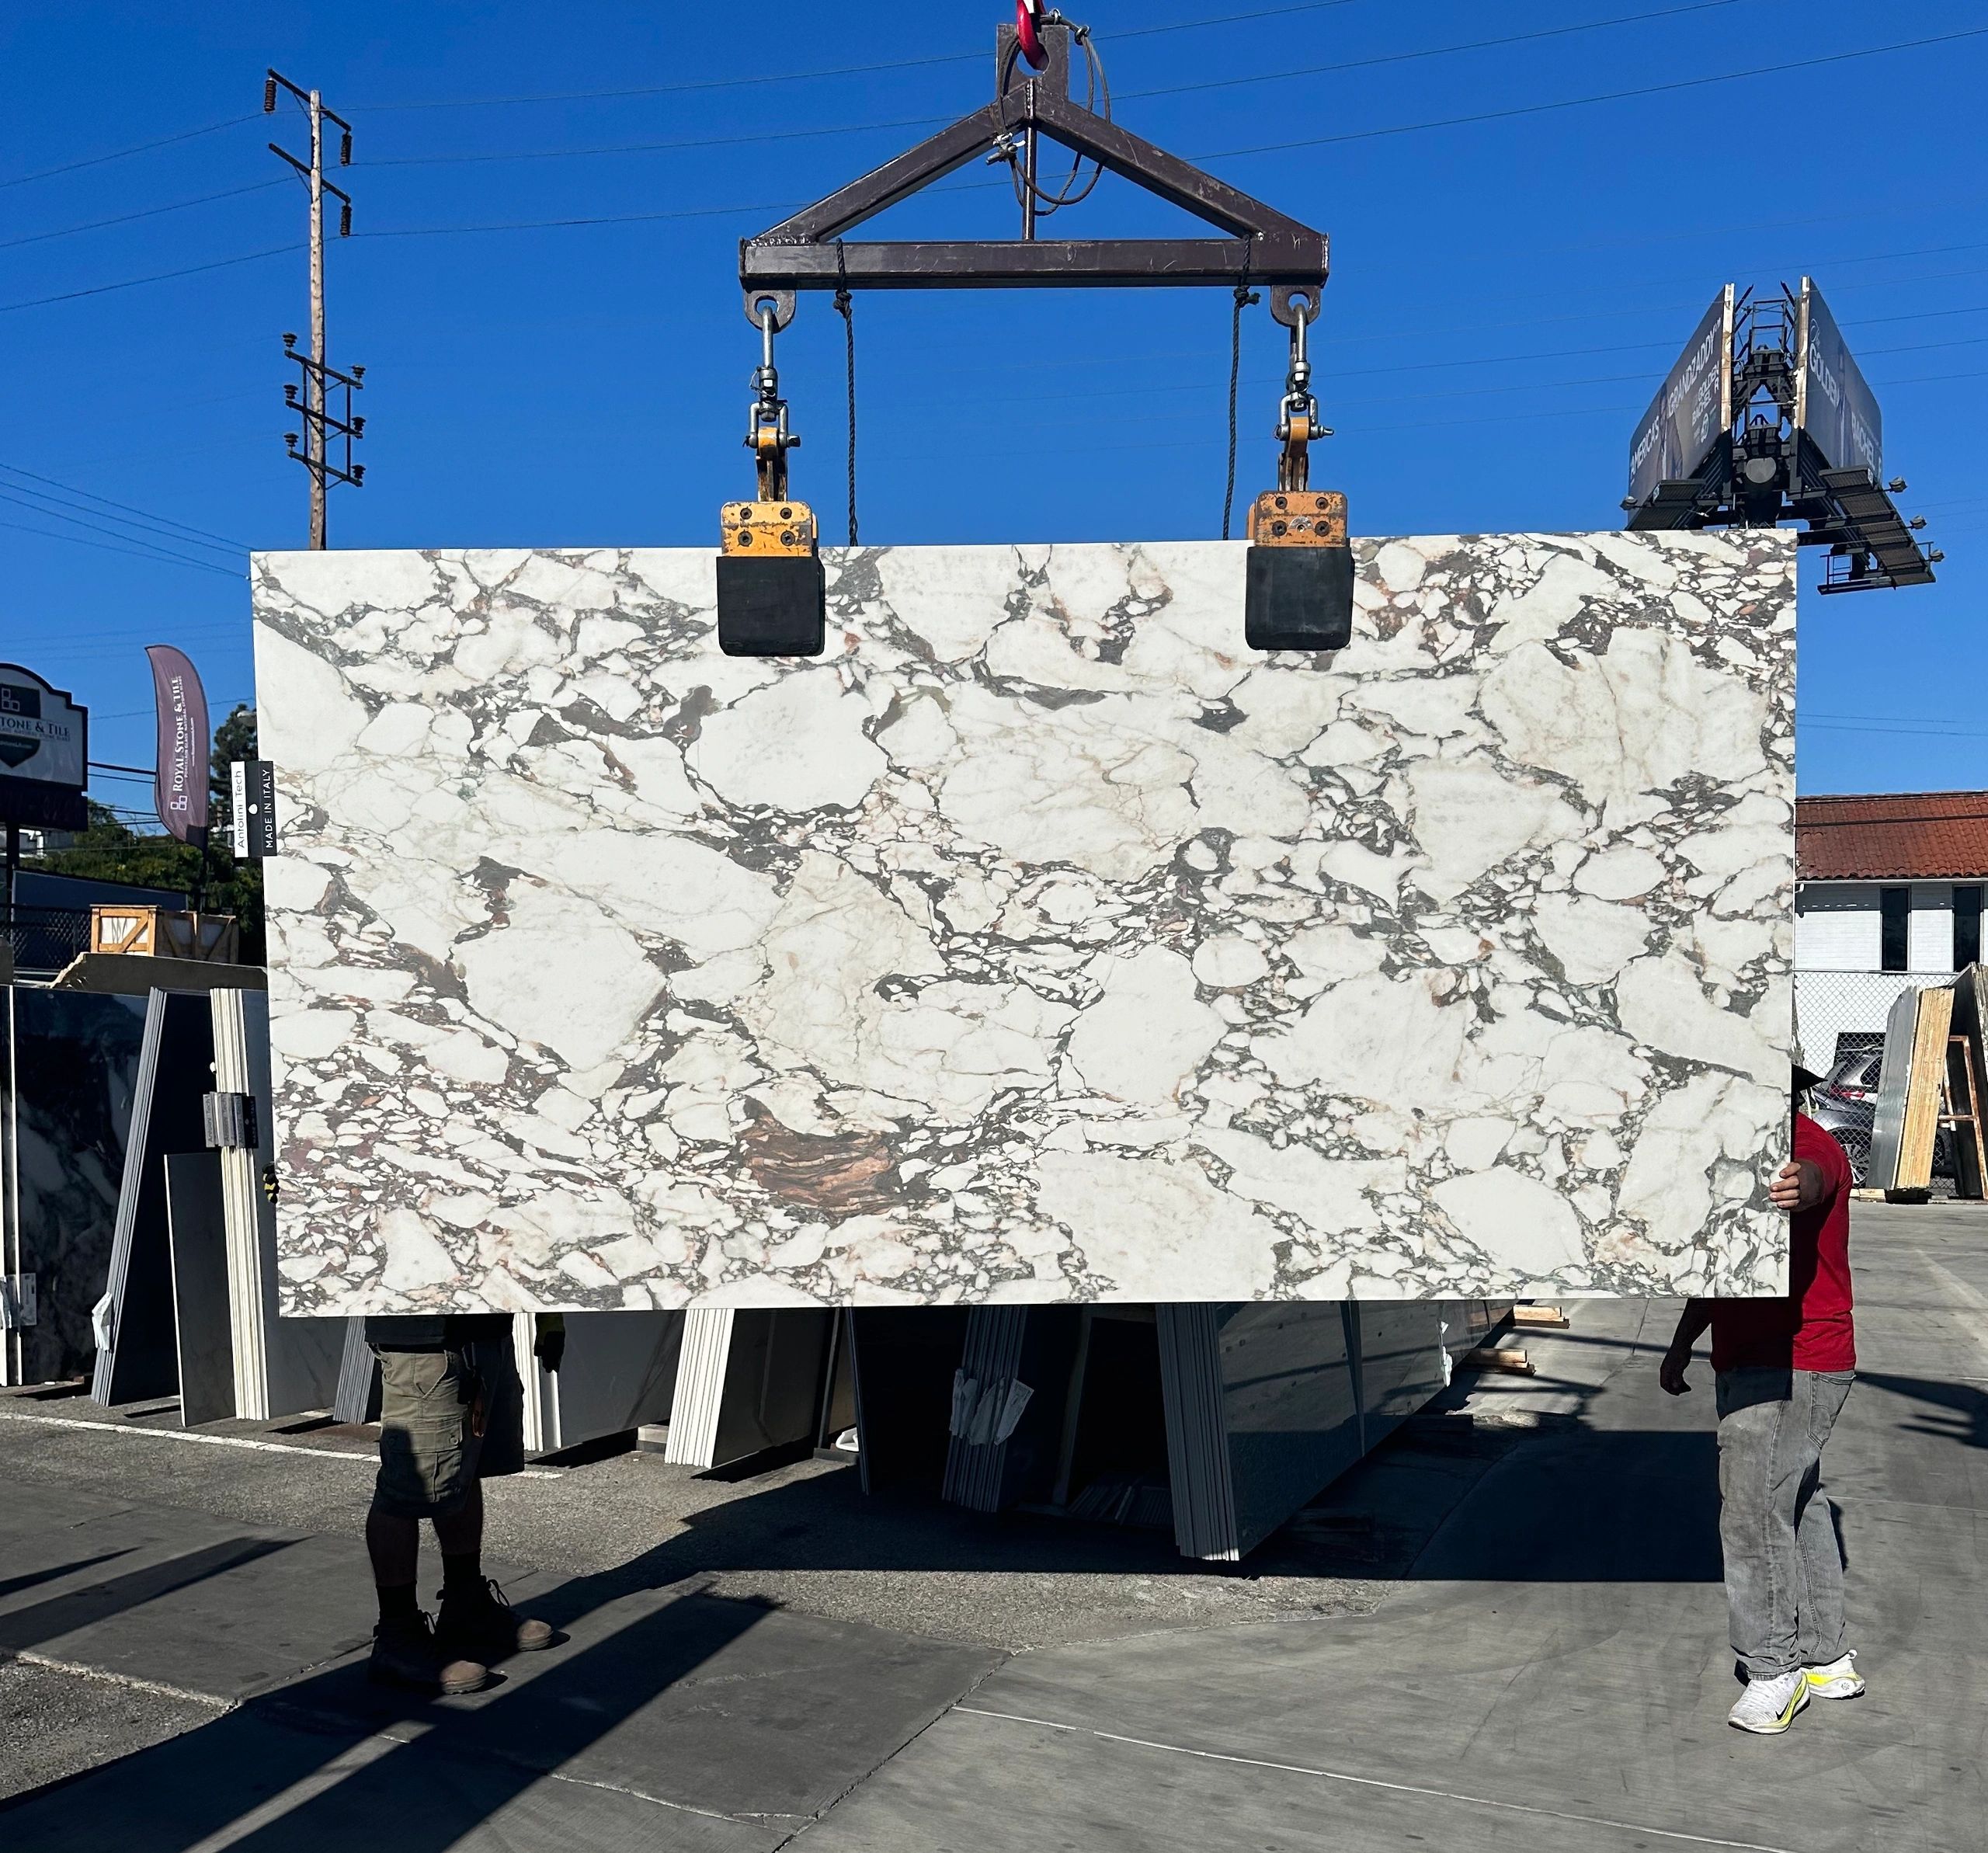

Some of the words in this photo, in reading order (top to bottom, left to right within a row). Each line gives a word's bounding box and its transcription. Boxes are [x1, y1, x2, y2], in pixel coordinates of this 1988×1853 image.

[171, 676, 181, 702] TILE
[173, 703, 182, 713] &
[35, 721, 44, 733] &
[47, 722, 69, 737] TILE
[175, 715, 184, 753] STONE
[172, 755, 184, 792] ROYAL
[262, 769, 271, 798] ITALY
[264, 803, 272, 813] IN
[236, 805, 245, 848] Antolini
[265, 817, 273, 848] MADE
